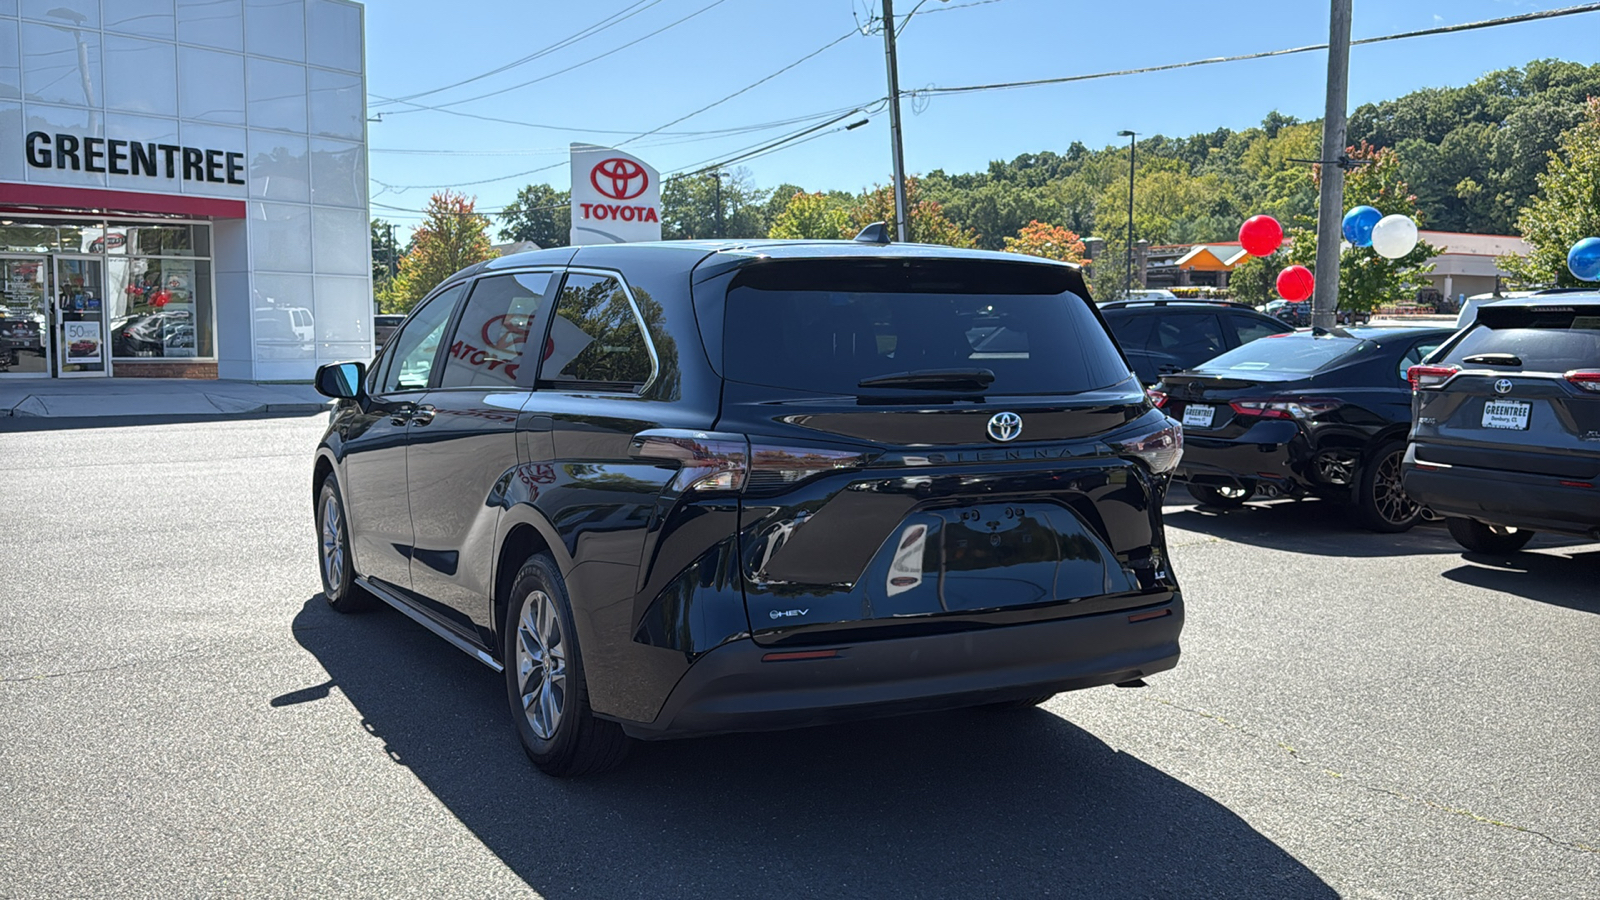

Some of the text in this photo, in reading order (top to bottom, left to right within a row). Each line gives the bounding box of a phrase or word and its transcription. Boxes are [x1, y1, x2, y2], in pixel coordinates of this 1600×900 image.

[26, 131, 245, 185] GREENTREE
[580, 203, 659, 223] TOYOTA
[69, 325, 84, 338] 50
[1185, 408, 1213, 418] GREENTREE
[1485, 404, 1528, 418] GREENTREE
[928, 448, 1073, 464] SIENNA
[778, 608, 810, 618] HEV
